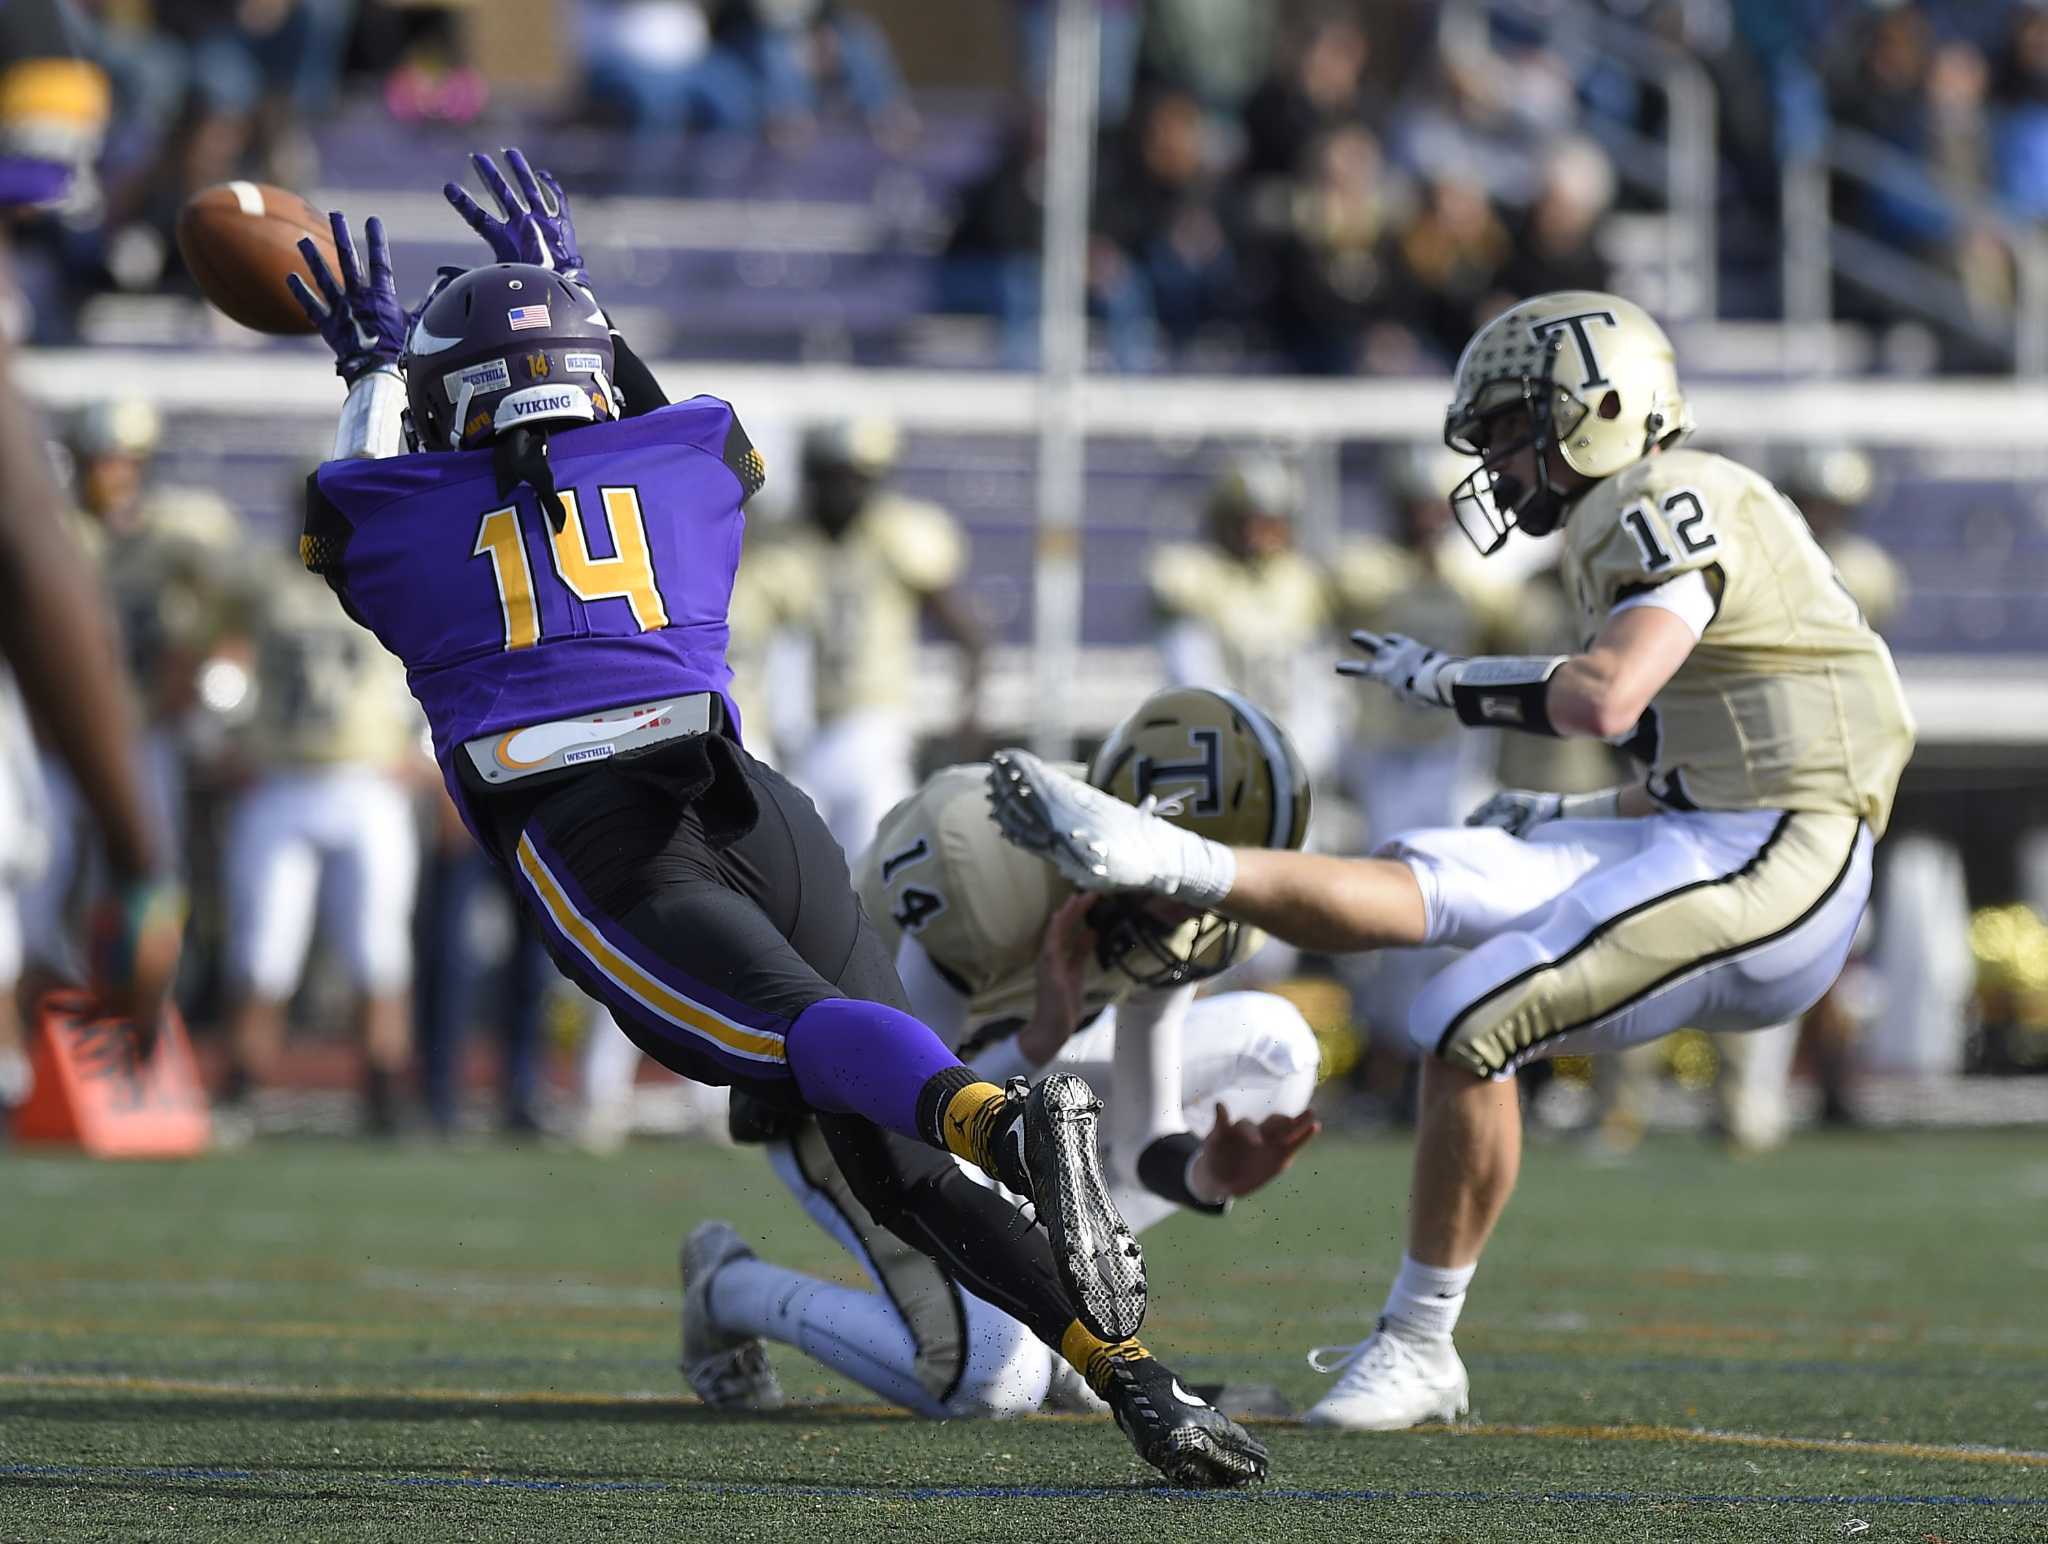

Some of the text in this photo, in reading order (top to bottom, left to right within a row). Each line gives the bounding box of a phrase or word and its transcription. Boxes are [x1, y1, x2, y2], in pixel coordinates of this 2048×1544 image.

[527, 353, 549, 378] 14
[566, 357, 601, 369] WESTHILL
[1529, 311, 1617, 389] T
[512, 395, 571, 416] VIKING
[471, 485, 671, 653] 14
[1621, 488, 1718, 572] 12
[566, 744, 614, 762] WESTHILL
[1135, 728, 1222, 816] T
[882, 838, 945, 932] 14
